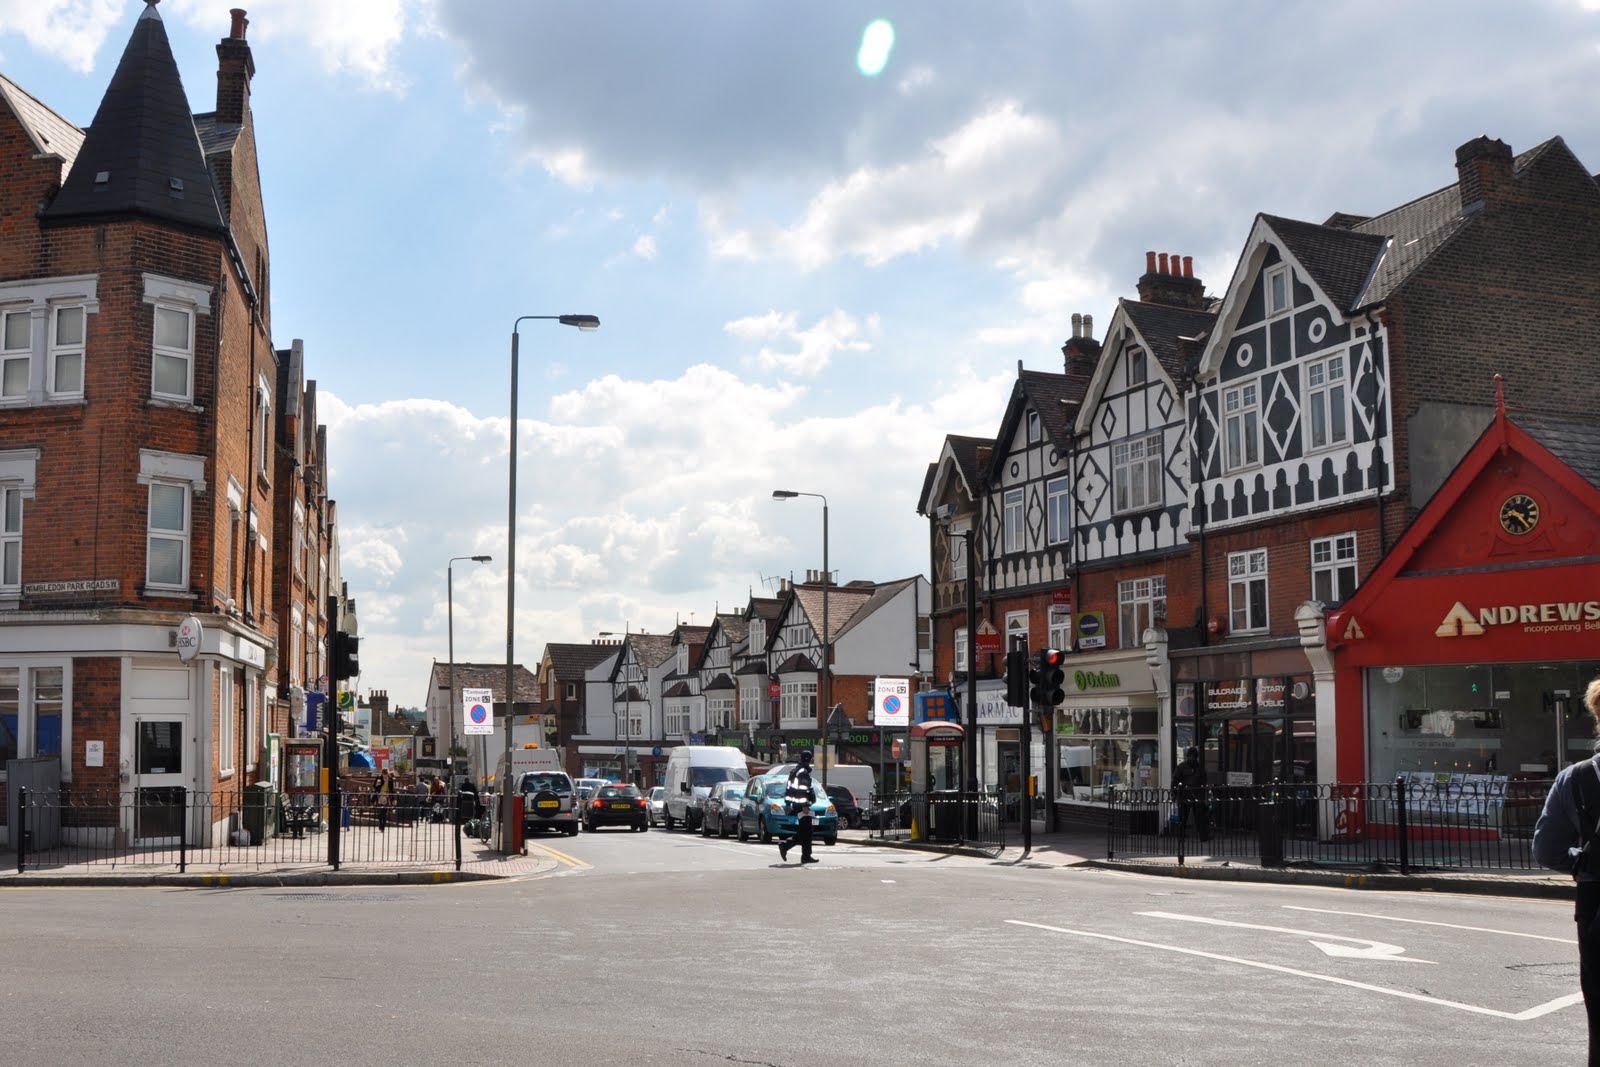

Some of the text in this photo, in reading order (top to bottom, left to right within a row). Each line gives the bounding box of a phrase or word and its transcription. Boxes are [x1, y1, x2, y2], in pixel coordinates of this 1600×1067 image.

[25, 583, 66, 592] WIMBLEDON
[67, 582, 85, 591] PARK
[86, 581, 104, 590] ROAD
[1524, 623, 1581, 634] incorporating
[1087, 671, 1120, 688] Oxfam
[967, 702, 1020, 718] ARMAC
[1208, 701, 1248, 710] SOLICITORS
[790, 738, 811, 747] OPEN
[848, 735, 869, 743] OOD
